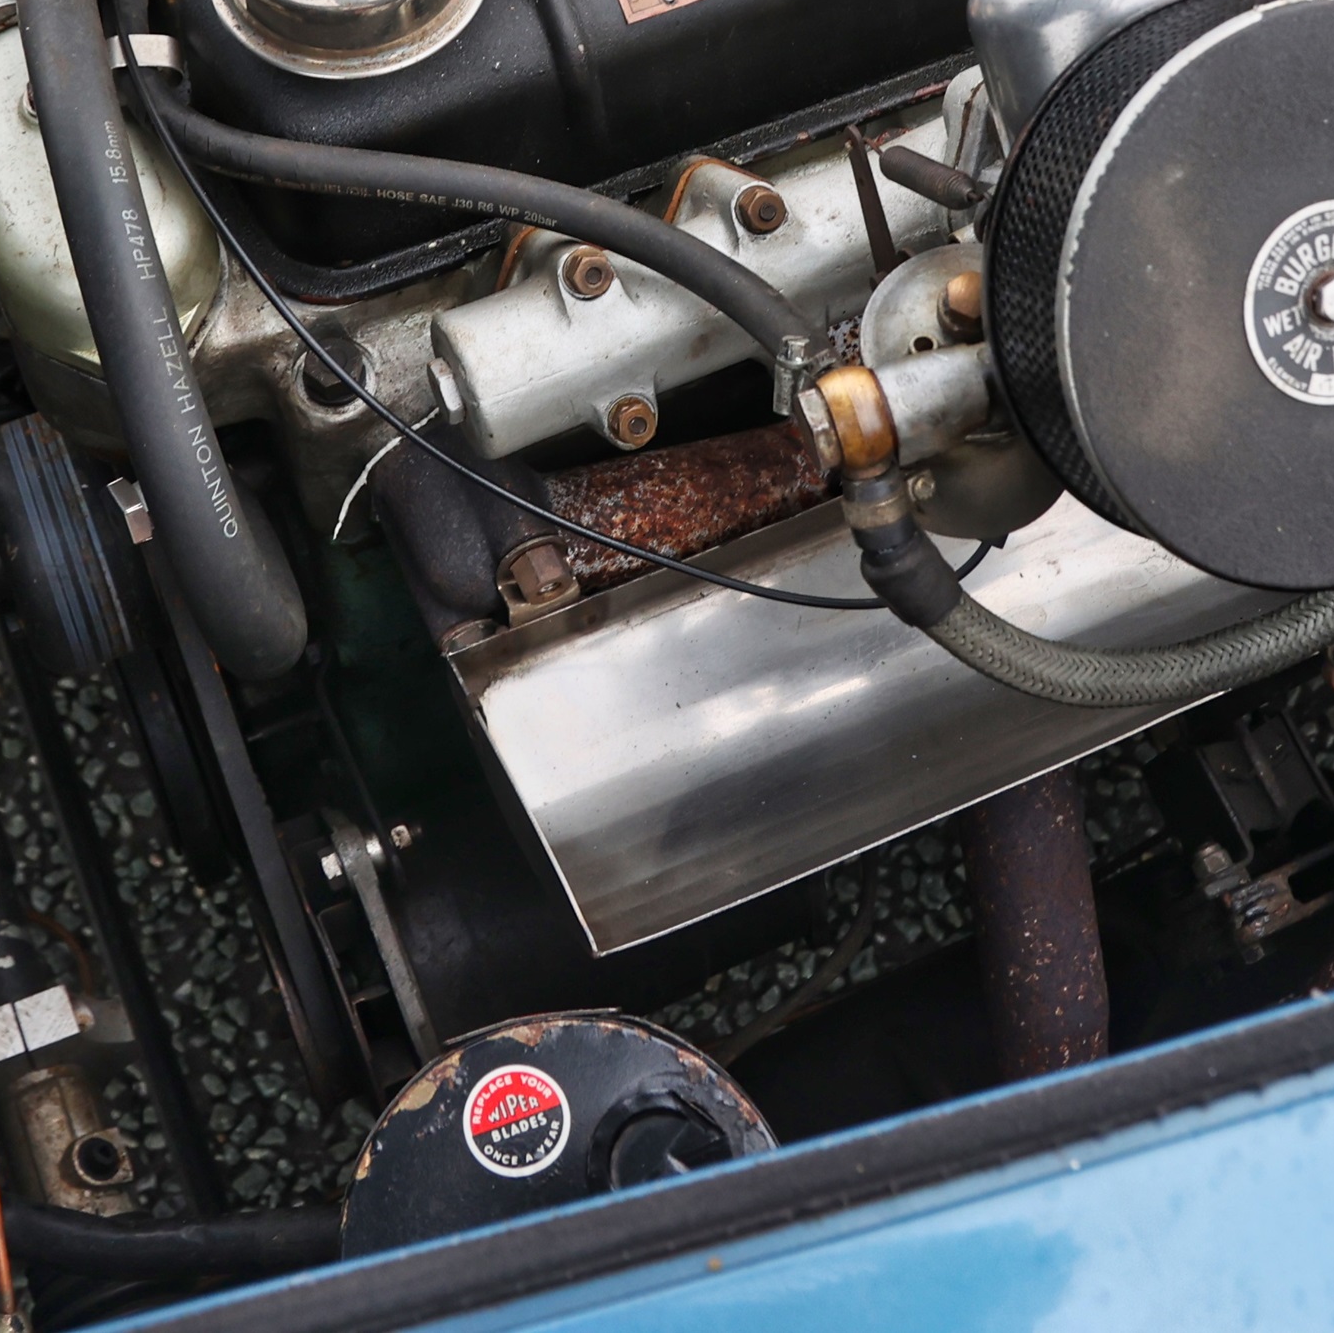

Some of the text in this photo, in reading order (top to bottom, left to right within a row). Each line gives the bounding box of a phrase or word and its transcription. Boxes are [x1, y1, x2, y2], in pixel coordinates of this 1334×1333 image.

[377, 189, 414, 202] HOSE
[419, 193, 446, 205] SAE
[452, 198, 472, 209] J30
[478, 201, 494, 212] R6
[499, 205, 520, 217] WP
[524, 211, 557, 227] 20bar
[105, 120, 239, 538] QUINTON HAZELL HP478 15.8mm
[1262, 308, 1302, 338] WET
[1283, 333, 1323, 372] AIR
[1266, 356, 1308, 392] ELEMENT
[472, 1075, 553, 1125] REPLACE YOUR
[488, 1094, 539, 1124] WIPER
[483, 1120, 560, 1165] ONCE A YEAR
[491, 1112, 548, 1143] BLADES
